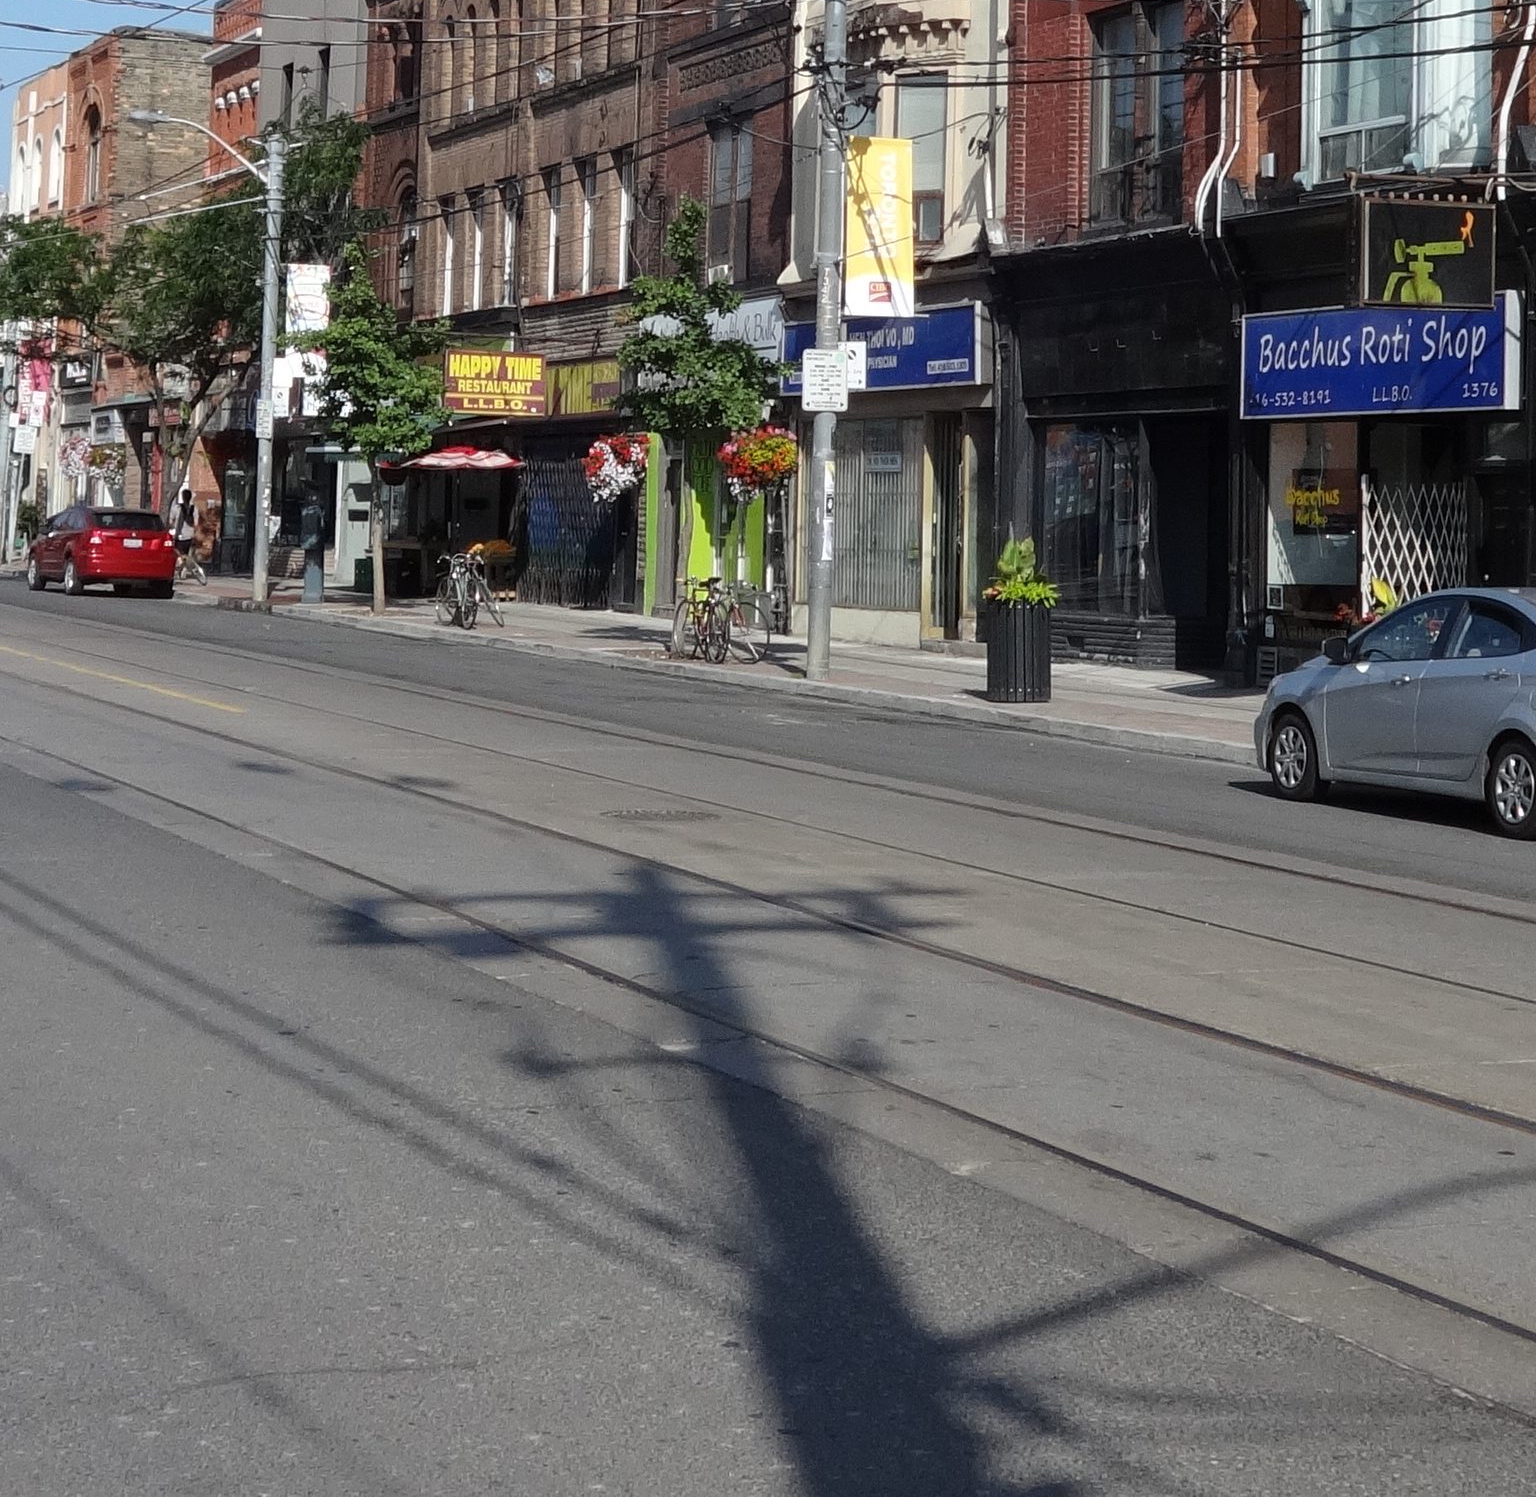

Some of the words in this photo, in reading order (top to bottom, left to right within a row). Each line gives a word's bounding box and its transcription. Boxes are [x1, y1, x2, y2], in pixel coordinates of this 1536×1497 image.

[880, 152, 897, 259] TORONTO
[753, 311, 778, 343] Bulk
[902, 325, 915, 346] MD
[1259, 325, 1352, 374] Bacchus
[1360, 317, 1412, 366] Roti
[1421, 314, 1487, 375] Shop
[449, 354, 501, 380] HAPPY
[505, 356, 543, 381] TIME
[457, 379, 533, 395] RESTAURANT
[1462, 382, 1498, 398] 1376
